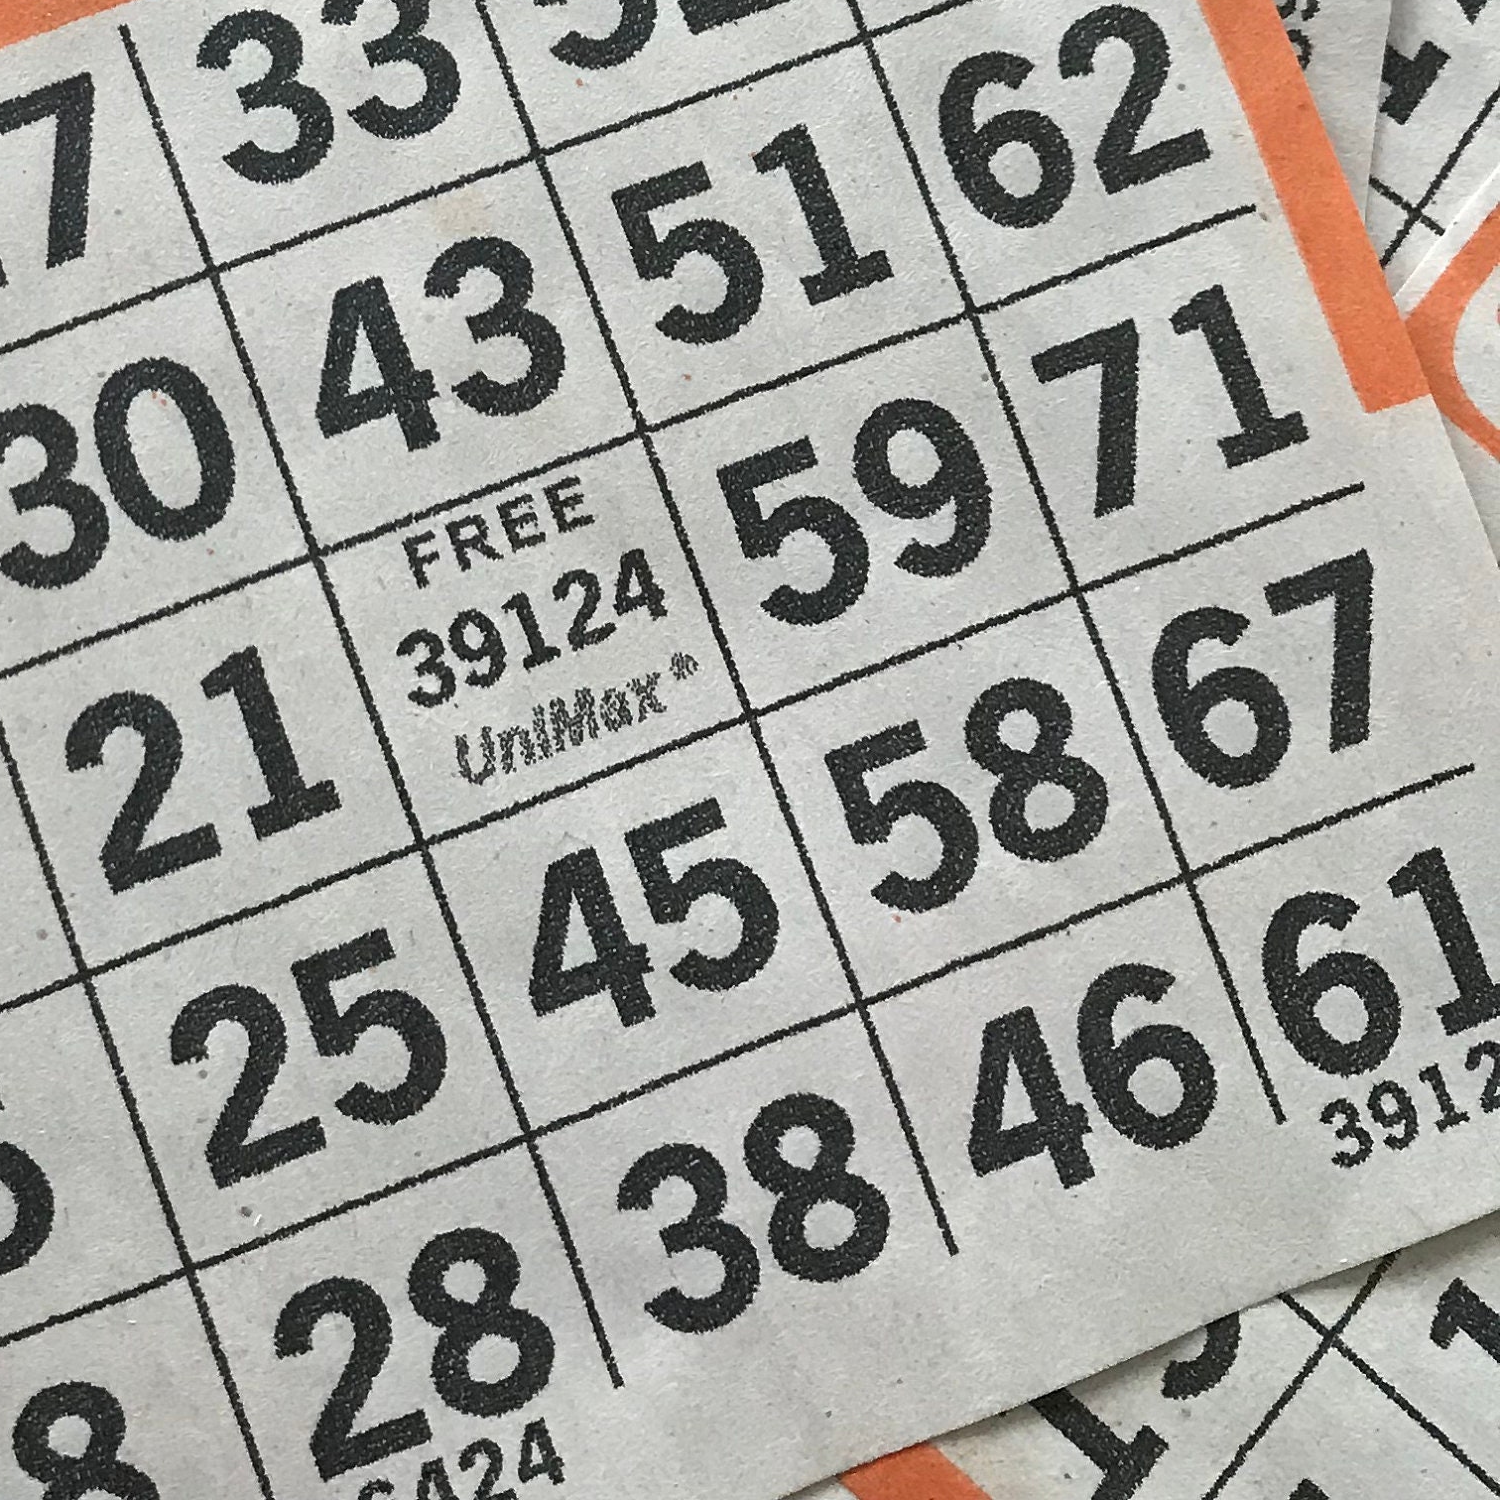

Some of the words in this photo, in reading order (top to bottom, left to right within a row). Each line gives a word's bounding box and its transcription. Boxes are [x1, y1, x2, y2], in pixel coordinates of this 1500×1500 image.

[314, 236, 566, 450] 43
[612, 124, 894, 343] 51
[938, 4, 1211, 228] 62
[66, 646, 341, 894] 21
[400, 475, 595, 589] FREE
[717, 398, 993, 625] 59
[1031, 285, 1309, 517] 71
[170, 928, 447, 1190] 25
[529, 797, 780, 1028] 45
[825, 677, 1107, 913] 58
[1151, 549, 1373, 789] 67
[396, 548, 668, 707] 39124
[11, 1380, 160, 1500] 8
[274, 1227, 555, 1482] 28
[617, 1093, 890, 1333] 38
[967, 962, 1217, 1190] 46
[1262, 846, 1500, 1078] 61
